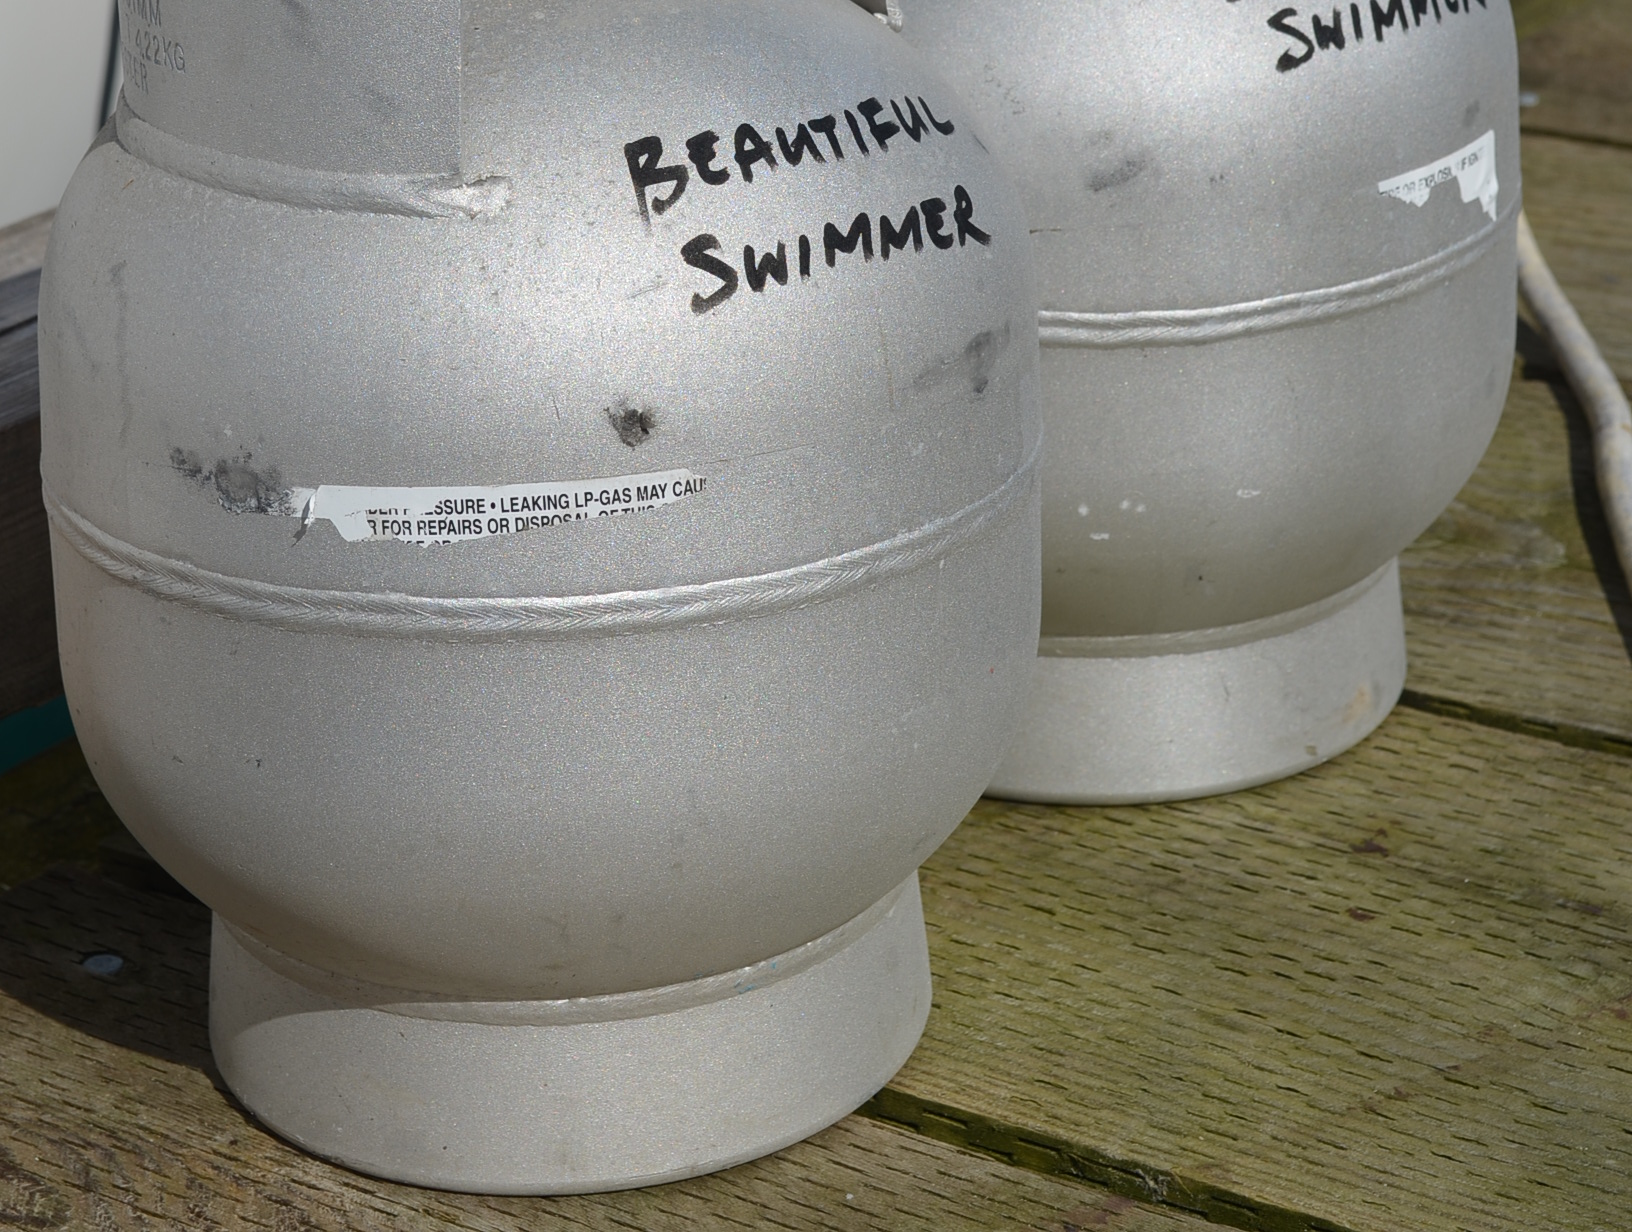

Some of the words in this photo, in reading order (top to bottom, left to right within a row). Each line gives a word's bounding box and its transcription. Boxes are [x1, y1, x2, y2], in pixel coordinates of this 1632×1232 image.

[624, 96, 955, 227] BEAUTIFUL
[681, 184, 992, 314] SWIMMER
[382, 520, 412, 536] FOR
[417, 518, 483, 536] REPAIRS
[487, 518, 511, 535] OR
[500, 493, 570, 514] LEAKING
[574, 487, 632, 508] LP-GAS
[636, 482, 668, 502] MAY
